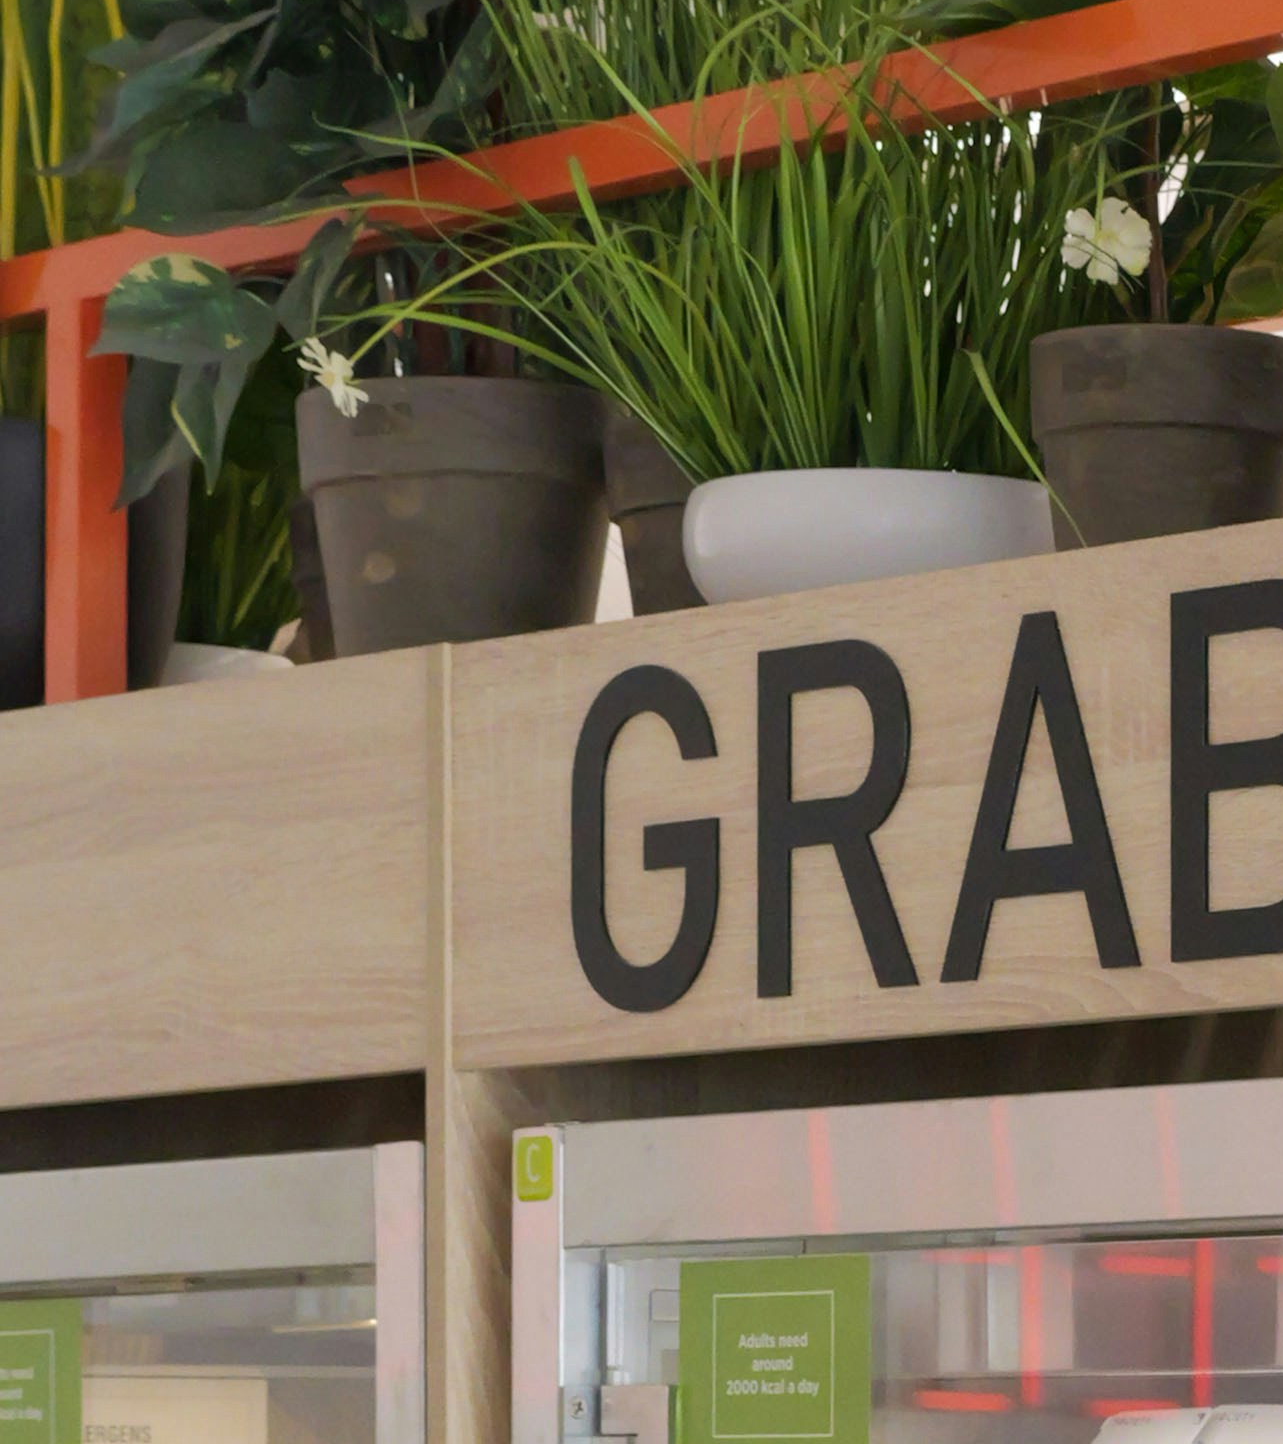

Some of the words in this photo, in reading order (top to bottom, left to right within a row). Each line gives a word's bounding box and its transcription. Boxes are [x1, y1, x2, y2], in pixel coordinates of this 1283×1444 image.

[738, 1333, 776, 1349] Adults
[778, 1332, 809, 1348] need
[751, 1356, 794, 1372] around
[726, 1379, 758, 1396] 2000
[760, 1379, 785, 1395] kcal
[787, 1382, 795, 1394] a
[797, 1379, 820, 1397] day
[82, 1425, 153, 1444] ERGENS
